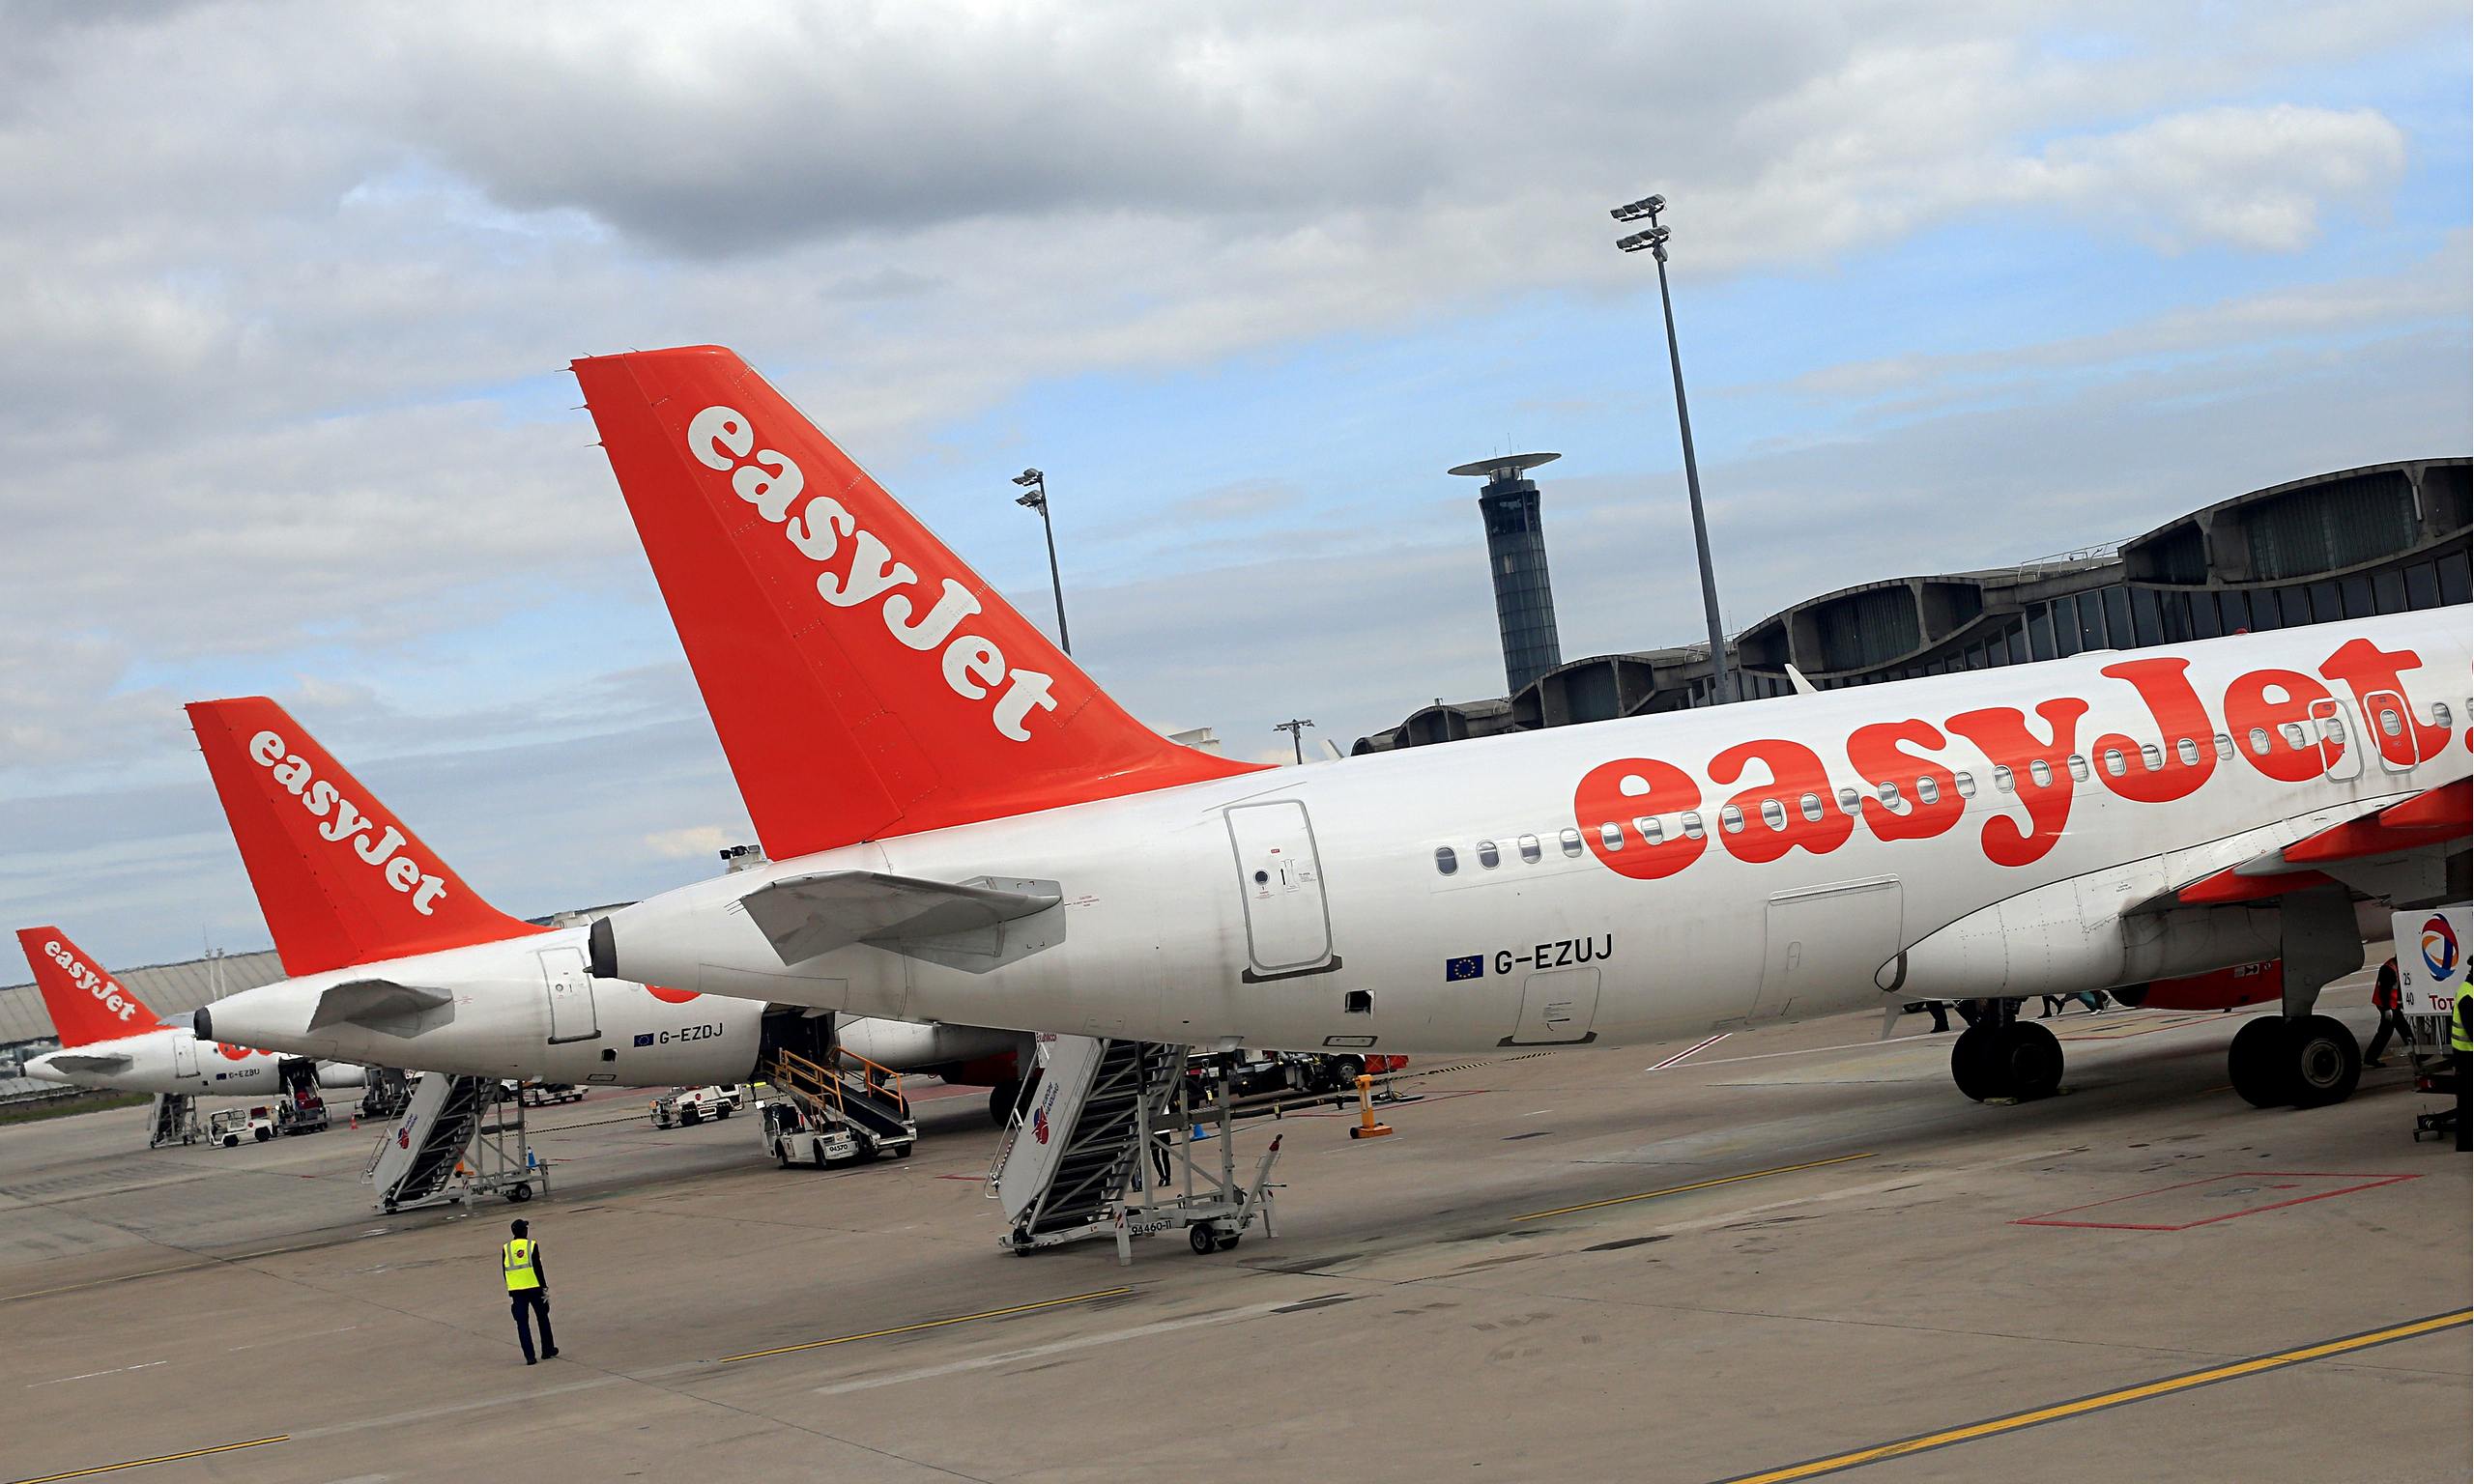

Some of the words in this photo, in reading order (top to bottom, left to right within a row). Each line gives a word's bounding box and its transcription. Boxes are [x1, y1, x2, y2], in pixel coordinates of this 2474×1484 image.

[687, 406, 1058, 742] easyJet
[249, 730, 446, 916] easyJet
[1495, 933, 1612, 975] G-EZUJ
[44, 941, 135, 1021] easyJet
[2403, 973, 2411, 985] 25
[2429, 995, 2455, 1011] TOT
[660, 1022, 723, 1044] G-EZDJ
